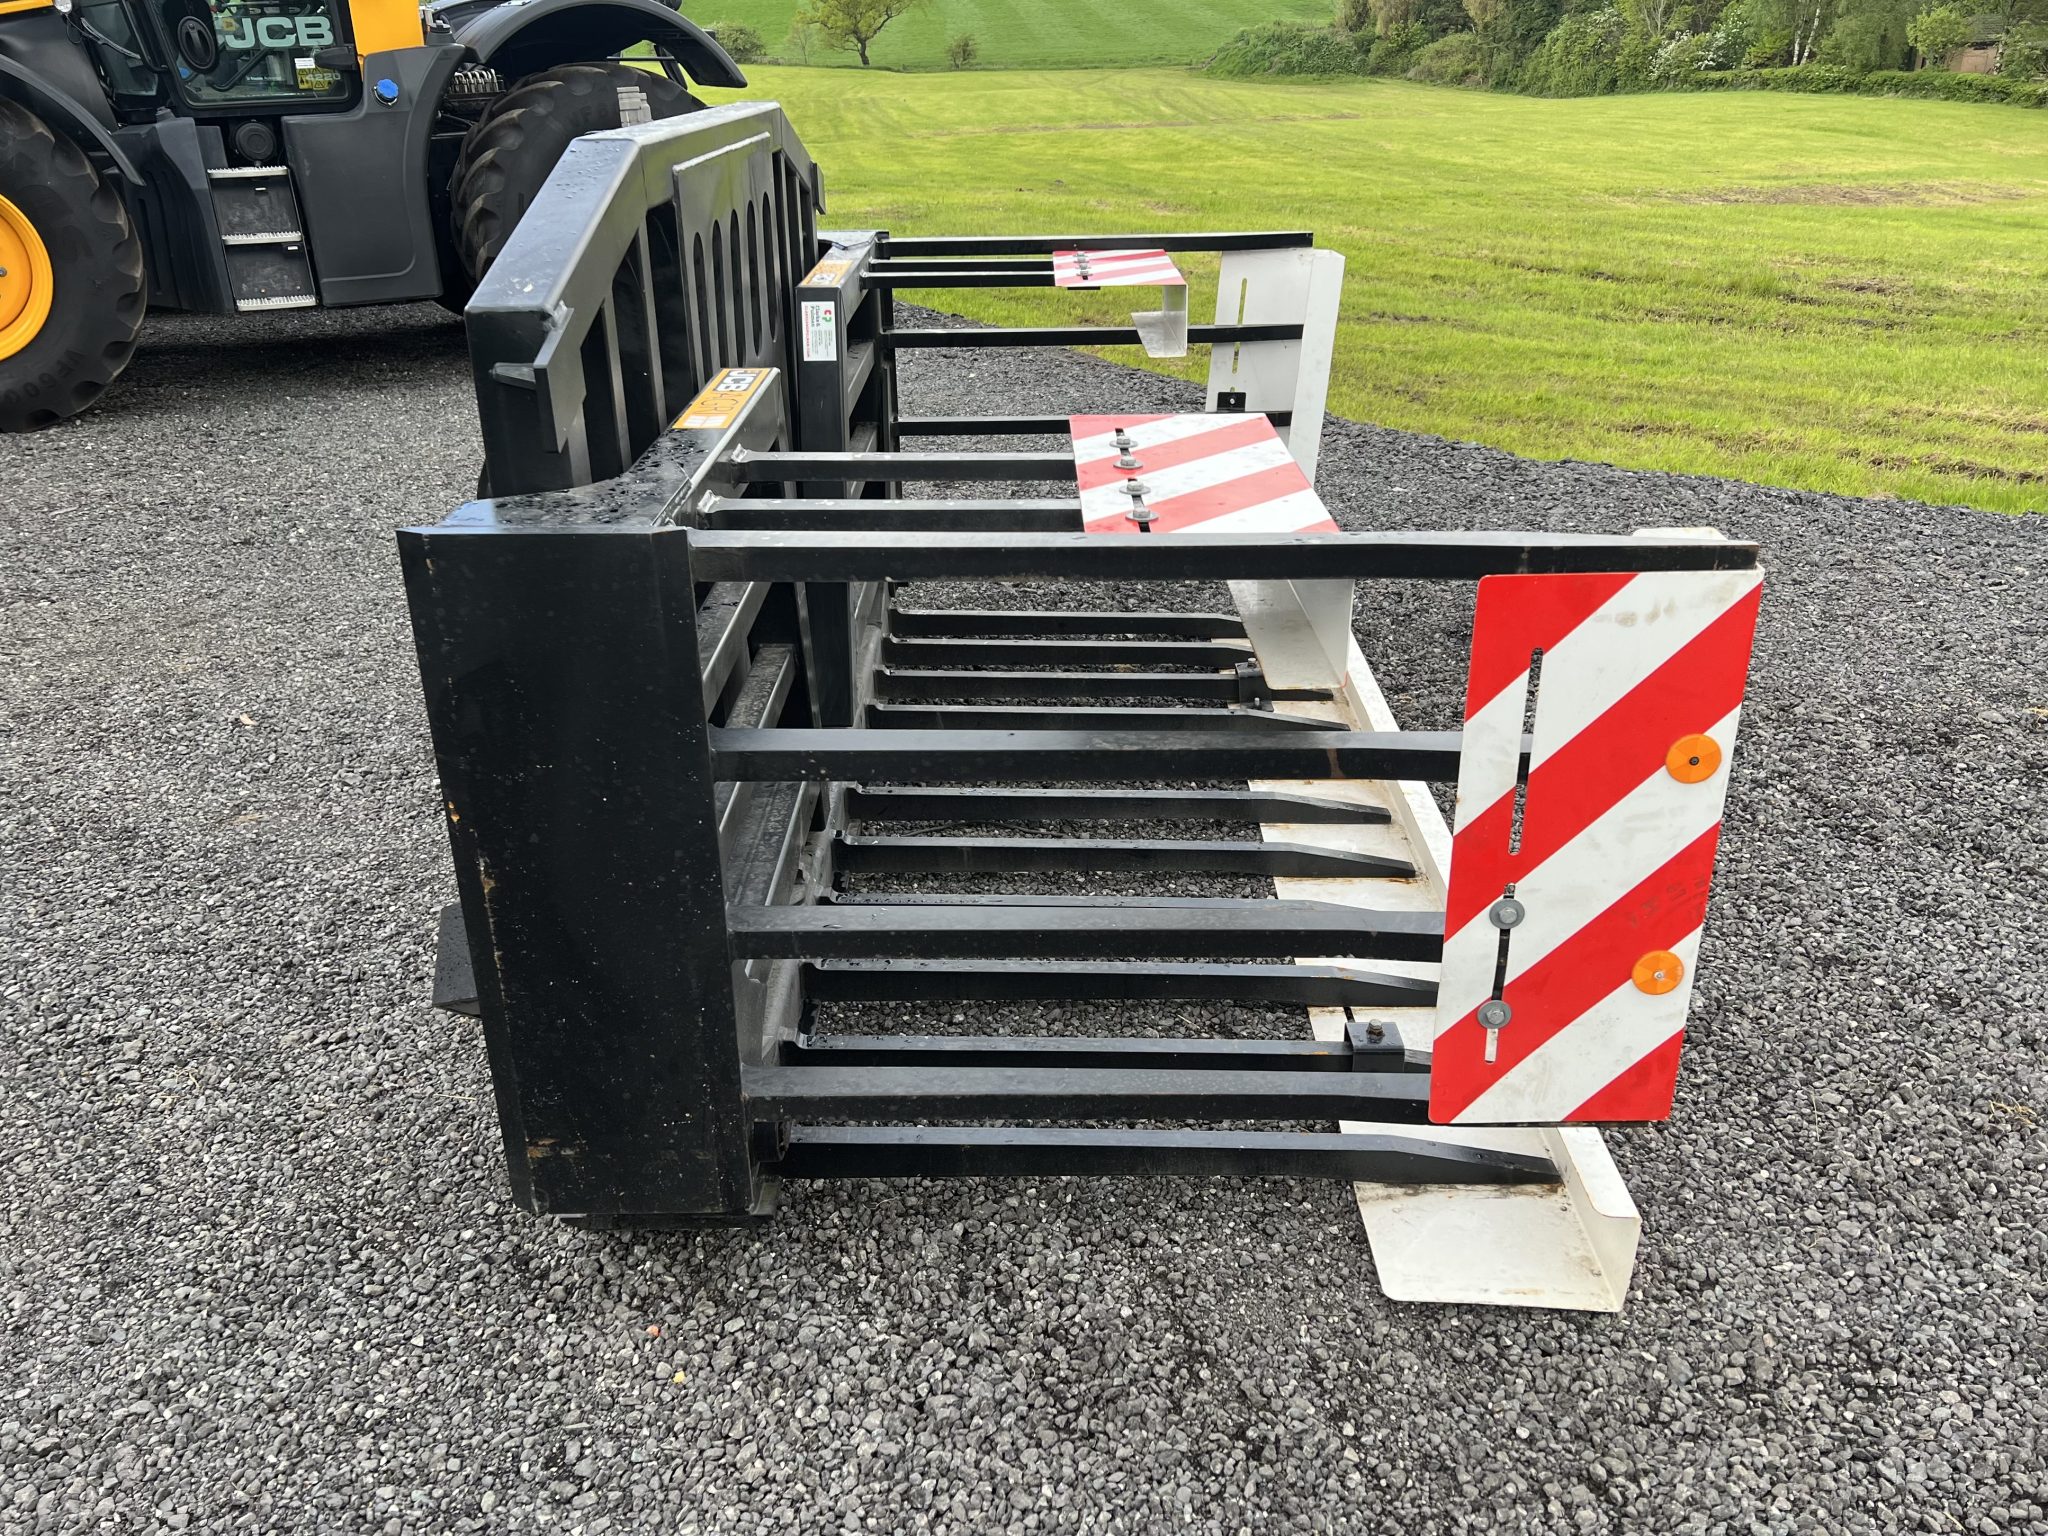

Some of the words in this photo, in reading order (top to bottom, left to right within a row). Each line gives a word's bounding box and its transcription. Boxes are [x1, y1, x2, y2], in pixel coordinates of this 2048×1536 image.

[225, 16, 334, 49] JCB
[305, 73, 341, 81] 4220
[715, 370, 758, 392] JCB
